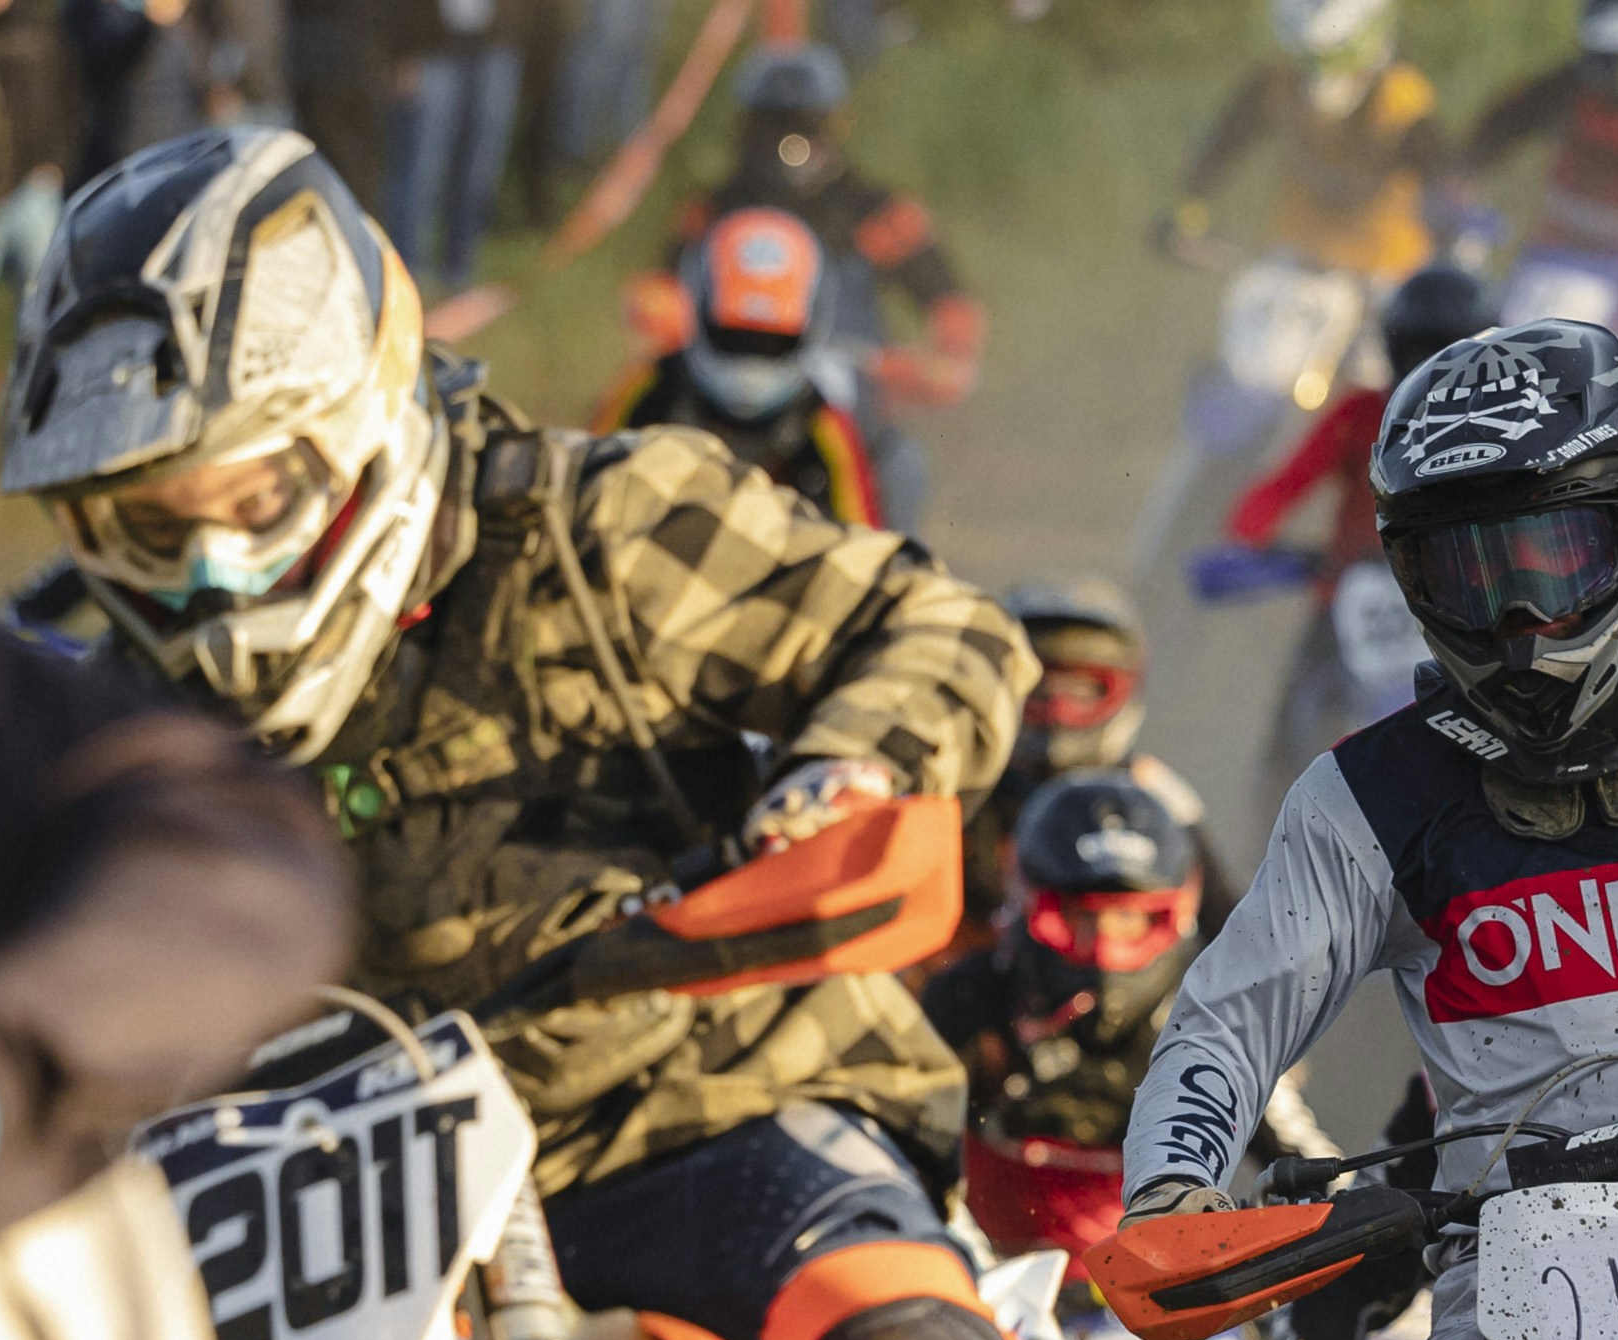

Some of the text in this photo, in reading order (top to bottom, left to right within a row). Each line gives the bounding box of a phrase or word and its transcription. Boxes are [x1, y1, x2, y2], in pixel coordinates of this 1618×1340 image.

[1556, 423, 1618, 459] GOOD TIMES
[1429, 448, 1492, 469] BELL
